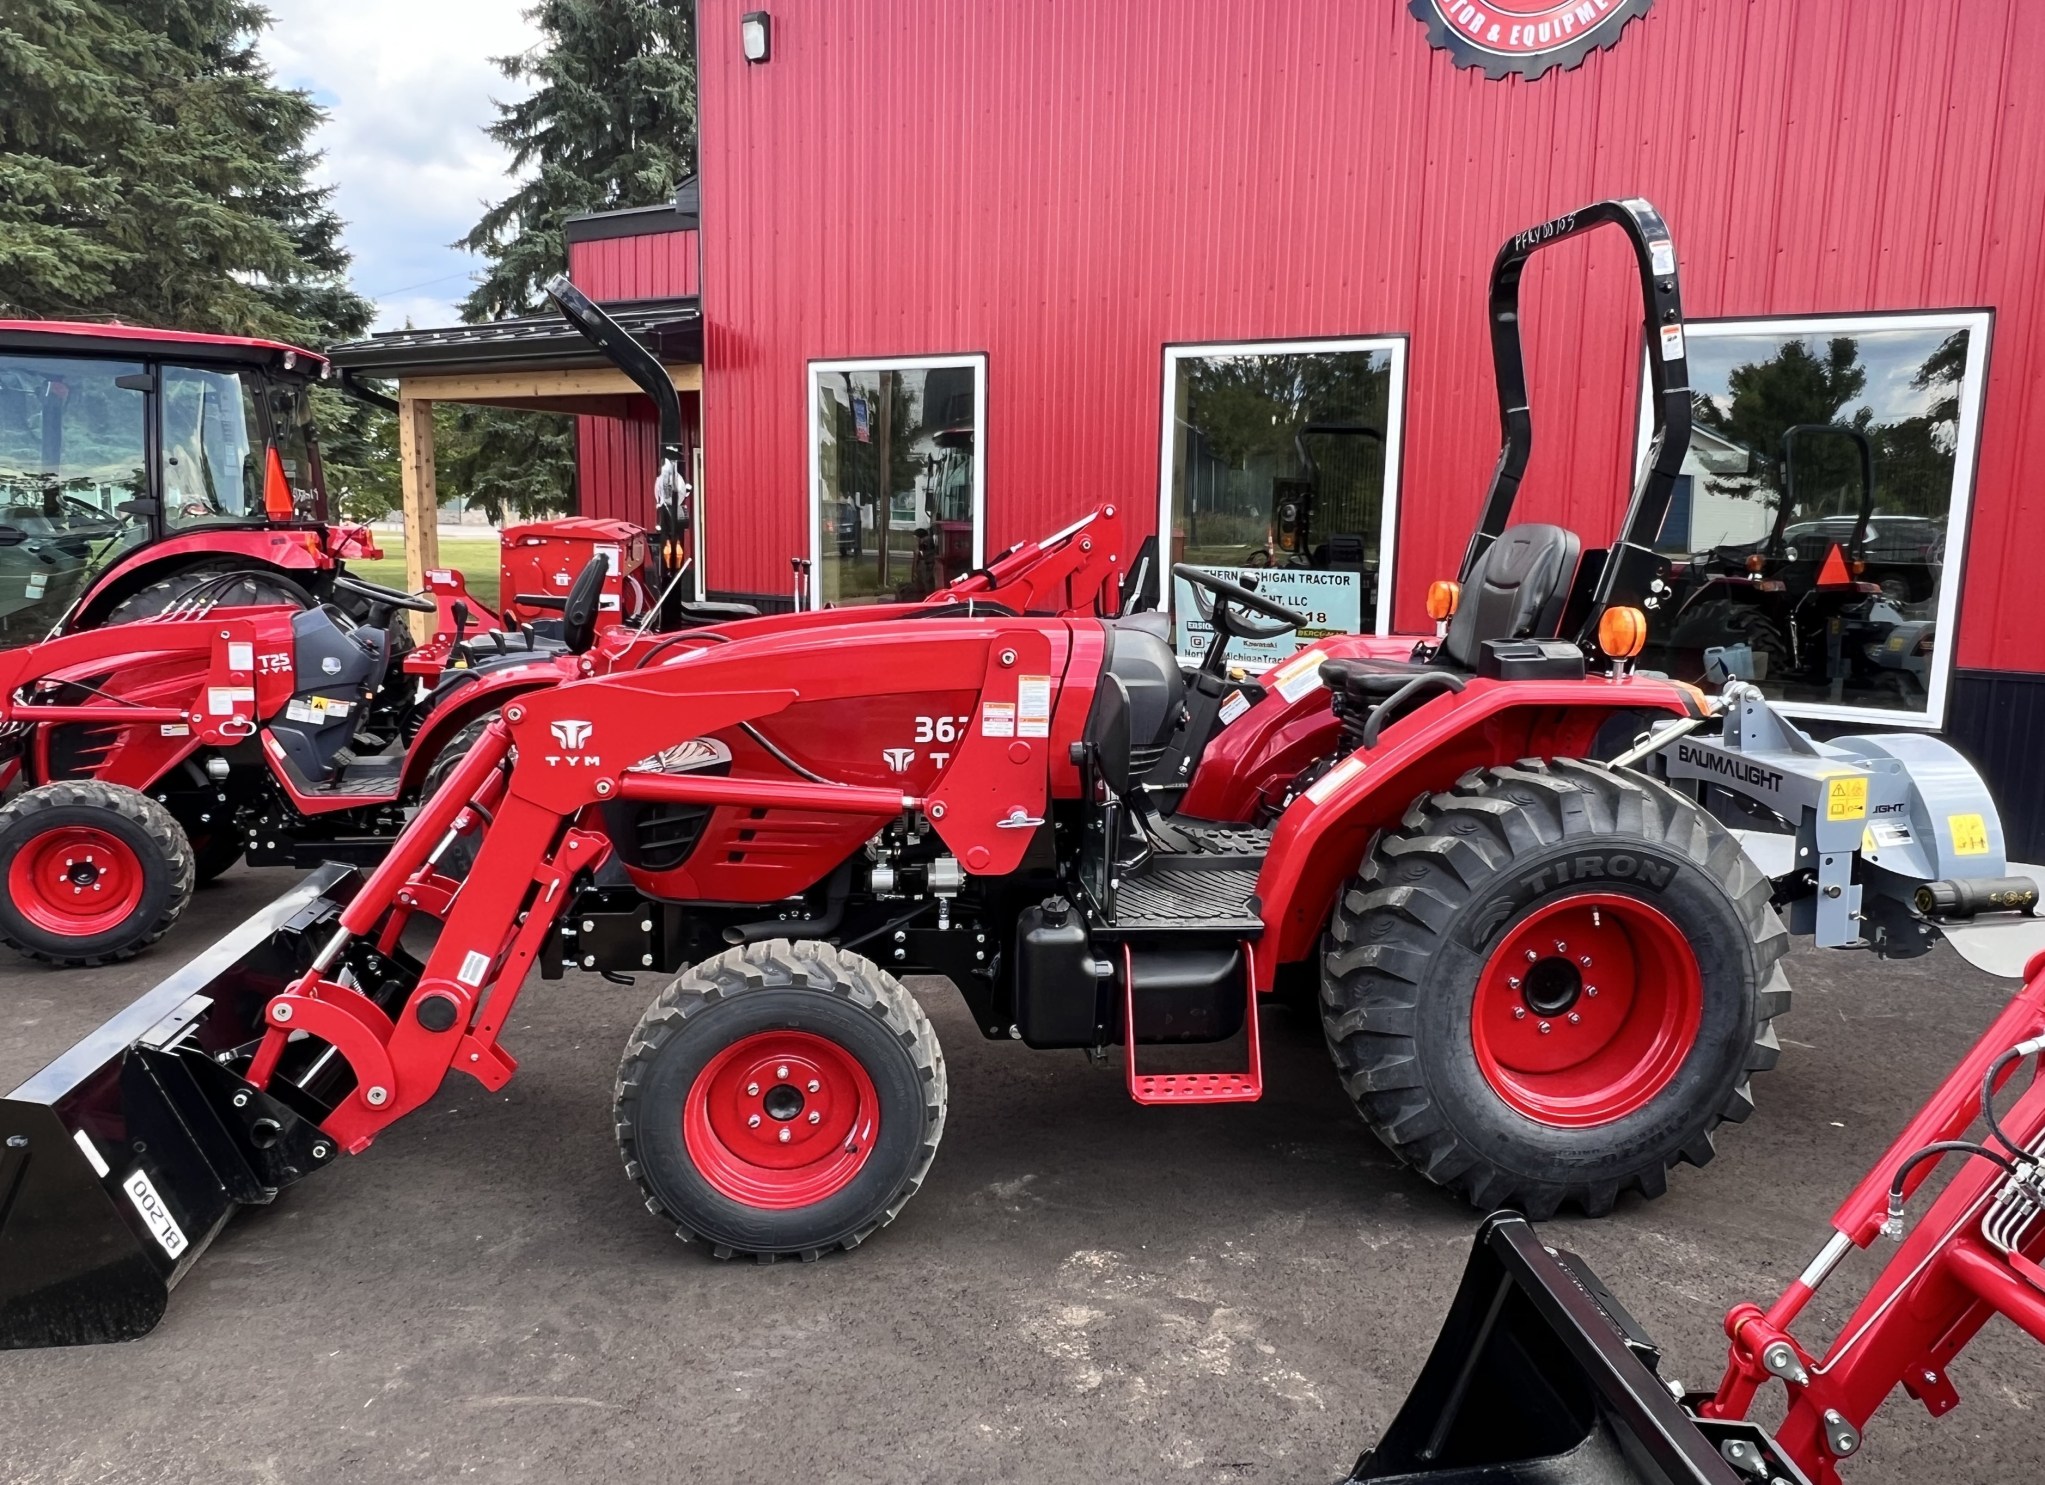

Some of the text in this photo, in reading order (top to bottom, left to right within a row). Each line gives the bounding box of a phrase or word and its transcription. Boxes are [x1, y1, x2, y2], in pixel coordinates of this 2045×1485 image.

[1443, 0, 1486, 34] TOR
[1487, 26, 1500, 43] &
[1300, 573, 1350, 586] TRACTOR
[1260, 584, 1267, 593] &
[1288, 596, 1308, 607] LLC
[257, 652, 291, 668] T25
[545, 755, 600, 767] TYM
[1678, 744, 1784, 793] BAUMALIGHT
[1519, 854, 1672, 895] TIRON
[132, 1180, 182, 1250] BL200
